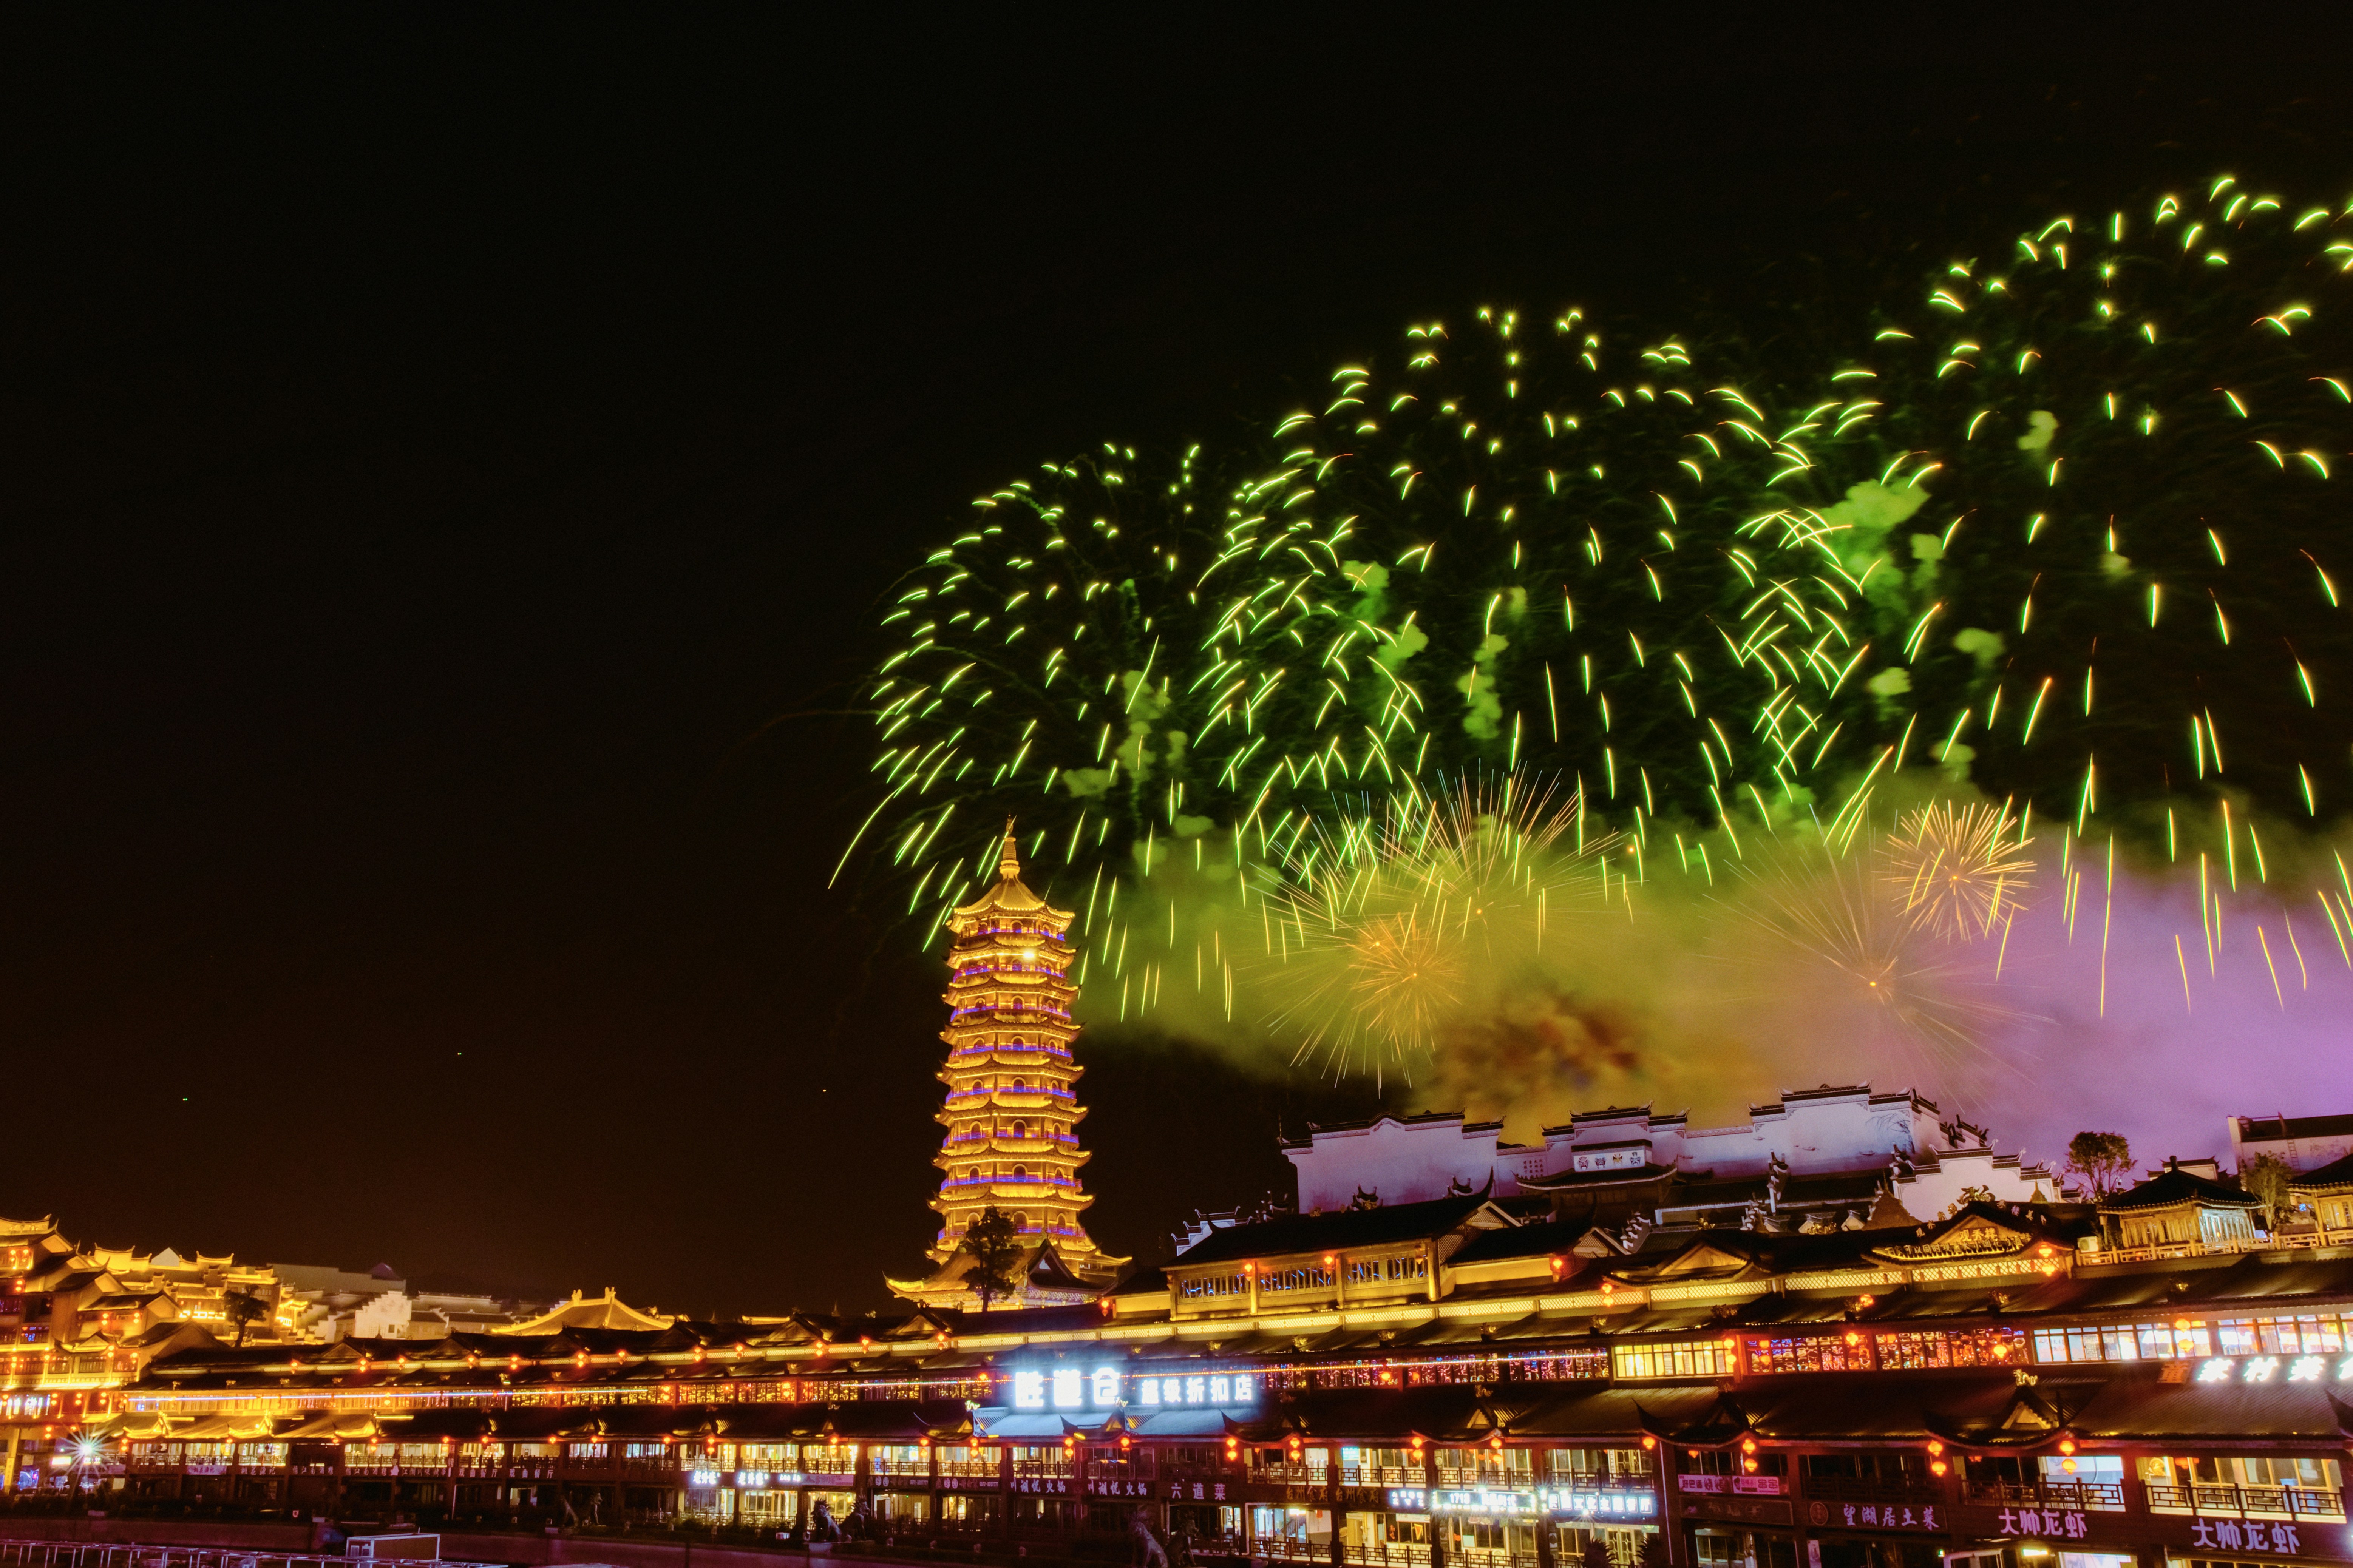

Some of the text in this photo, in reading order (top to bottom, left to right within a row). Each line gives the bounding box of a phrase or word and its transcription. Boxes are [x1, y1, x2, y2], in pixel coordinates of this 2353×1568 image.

[1959, 1227, 1998, 1242] 观秀楼
[1142, 1375, 1252, 1404] 超级折扣店
[509, 1468, 554, 1479] 戏曲餐厅
[1757, 1479, 1778, 1489] 串串
[1171, 1482, 1226, 1501] 六道菜
[1843, 1503, 1939, 1530] 望湖居土菜
[1998, 1508, 2088, 1538] 大帅龙虾
[2191, 1517, 2300, 1554] 大帅龙虾
